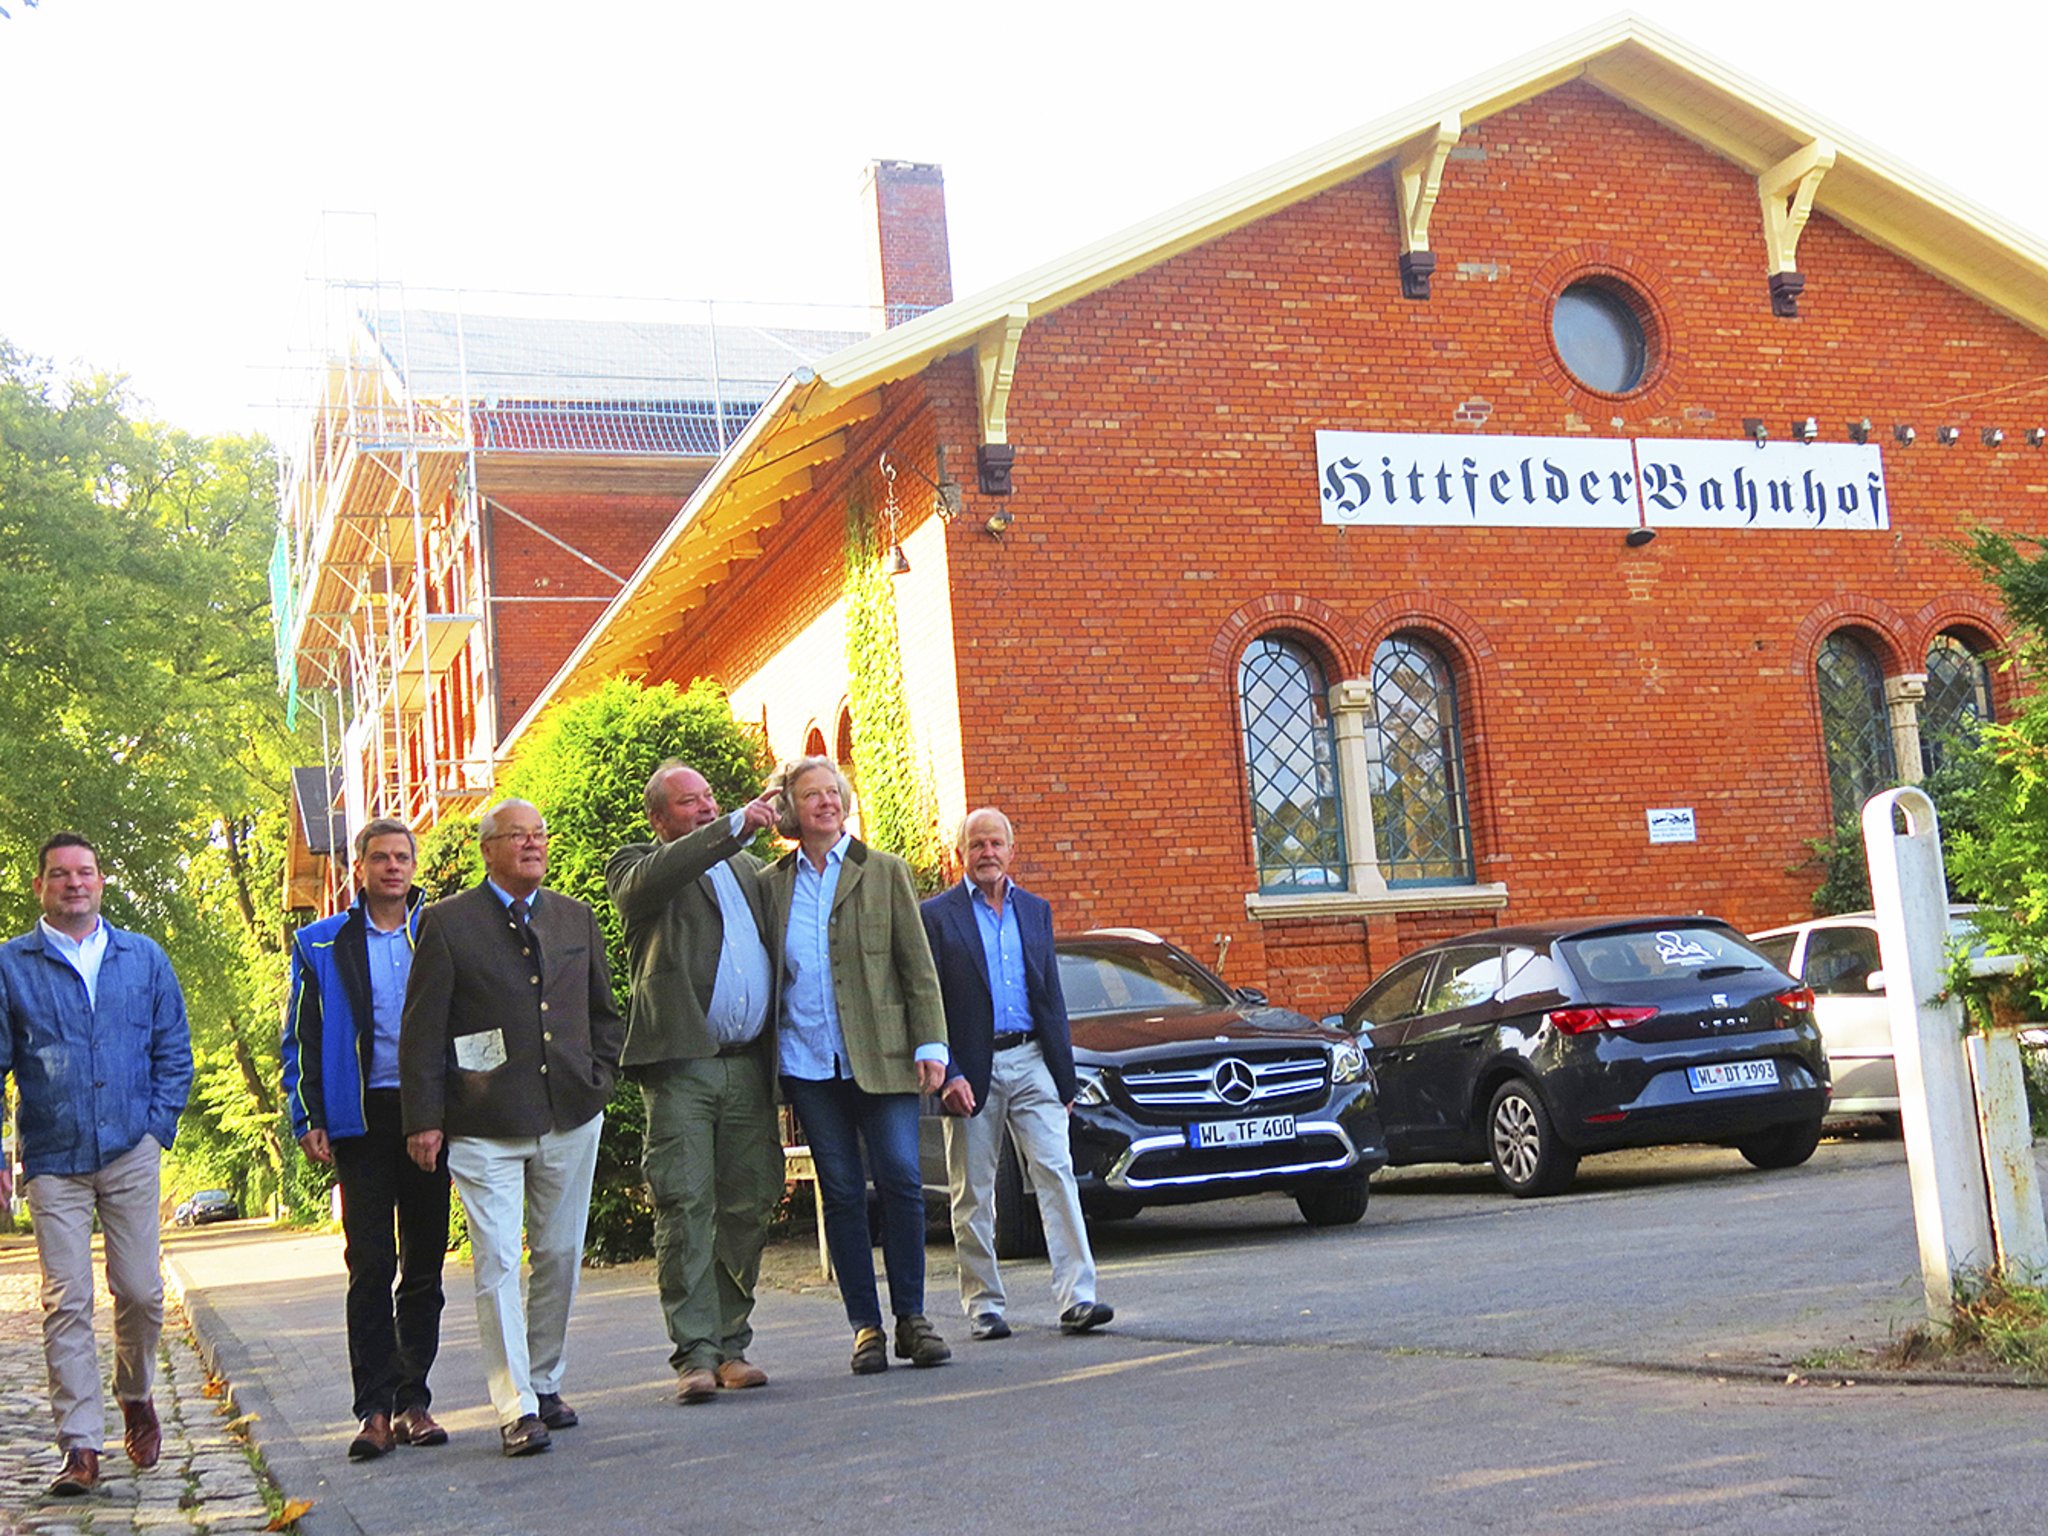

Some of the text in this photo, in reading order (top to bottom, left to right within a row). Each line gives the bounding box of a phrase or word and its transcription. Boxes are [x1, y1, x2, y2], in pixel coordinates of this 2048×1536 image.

[1322, 455, 1883, 530] Hittfelder Bahnhof
[1699, 1016, 1749, 1029] LEON
[1697, 1062, 1775, 1086] WL DT 1993
[1201, 1117, 1294, 1144] WL TF 400
